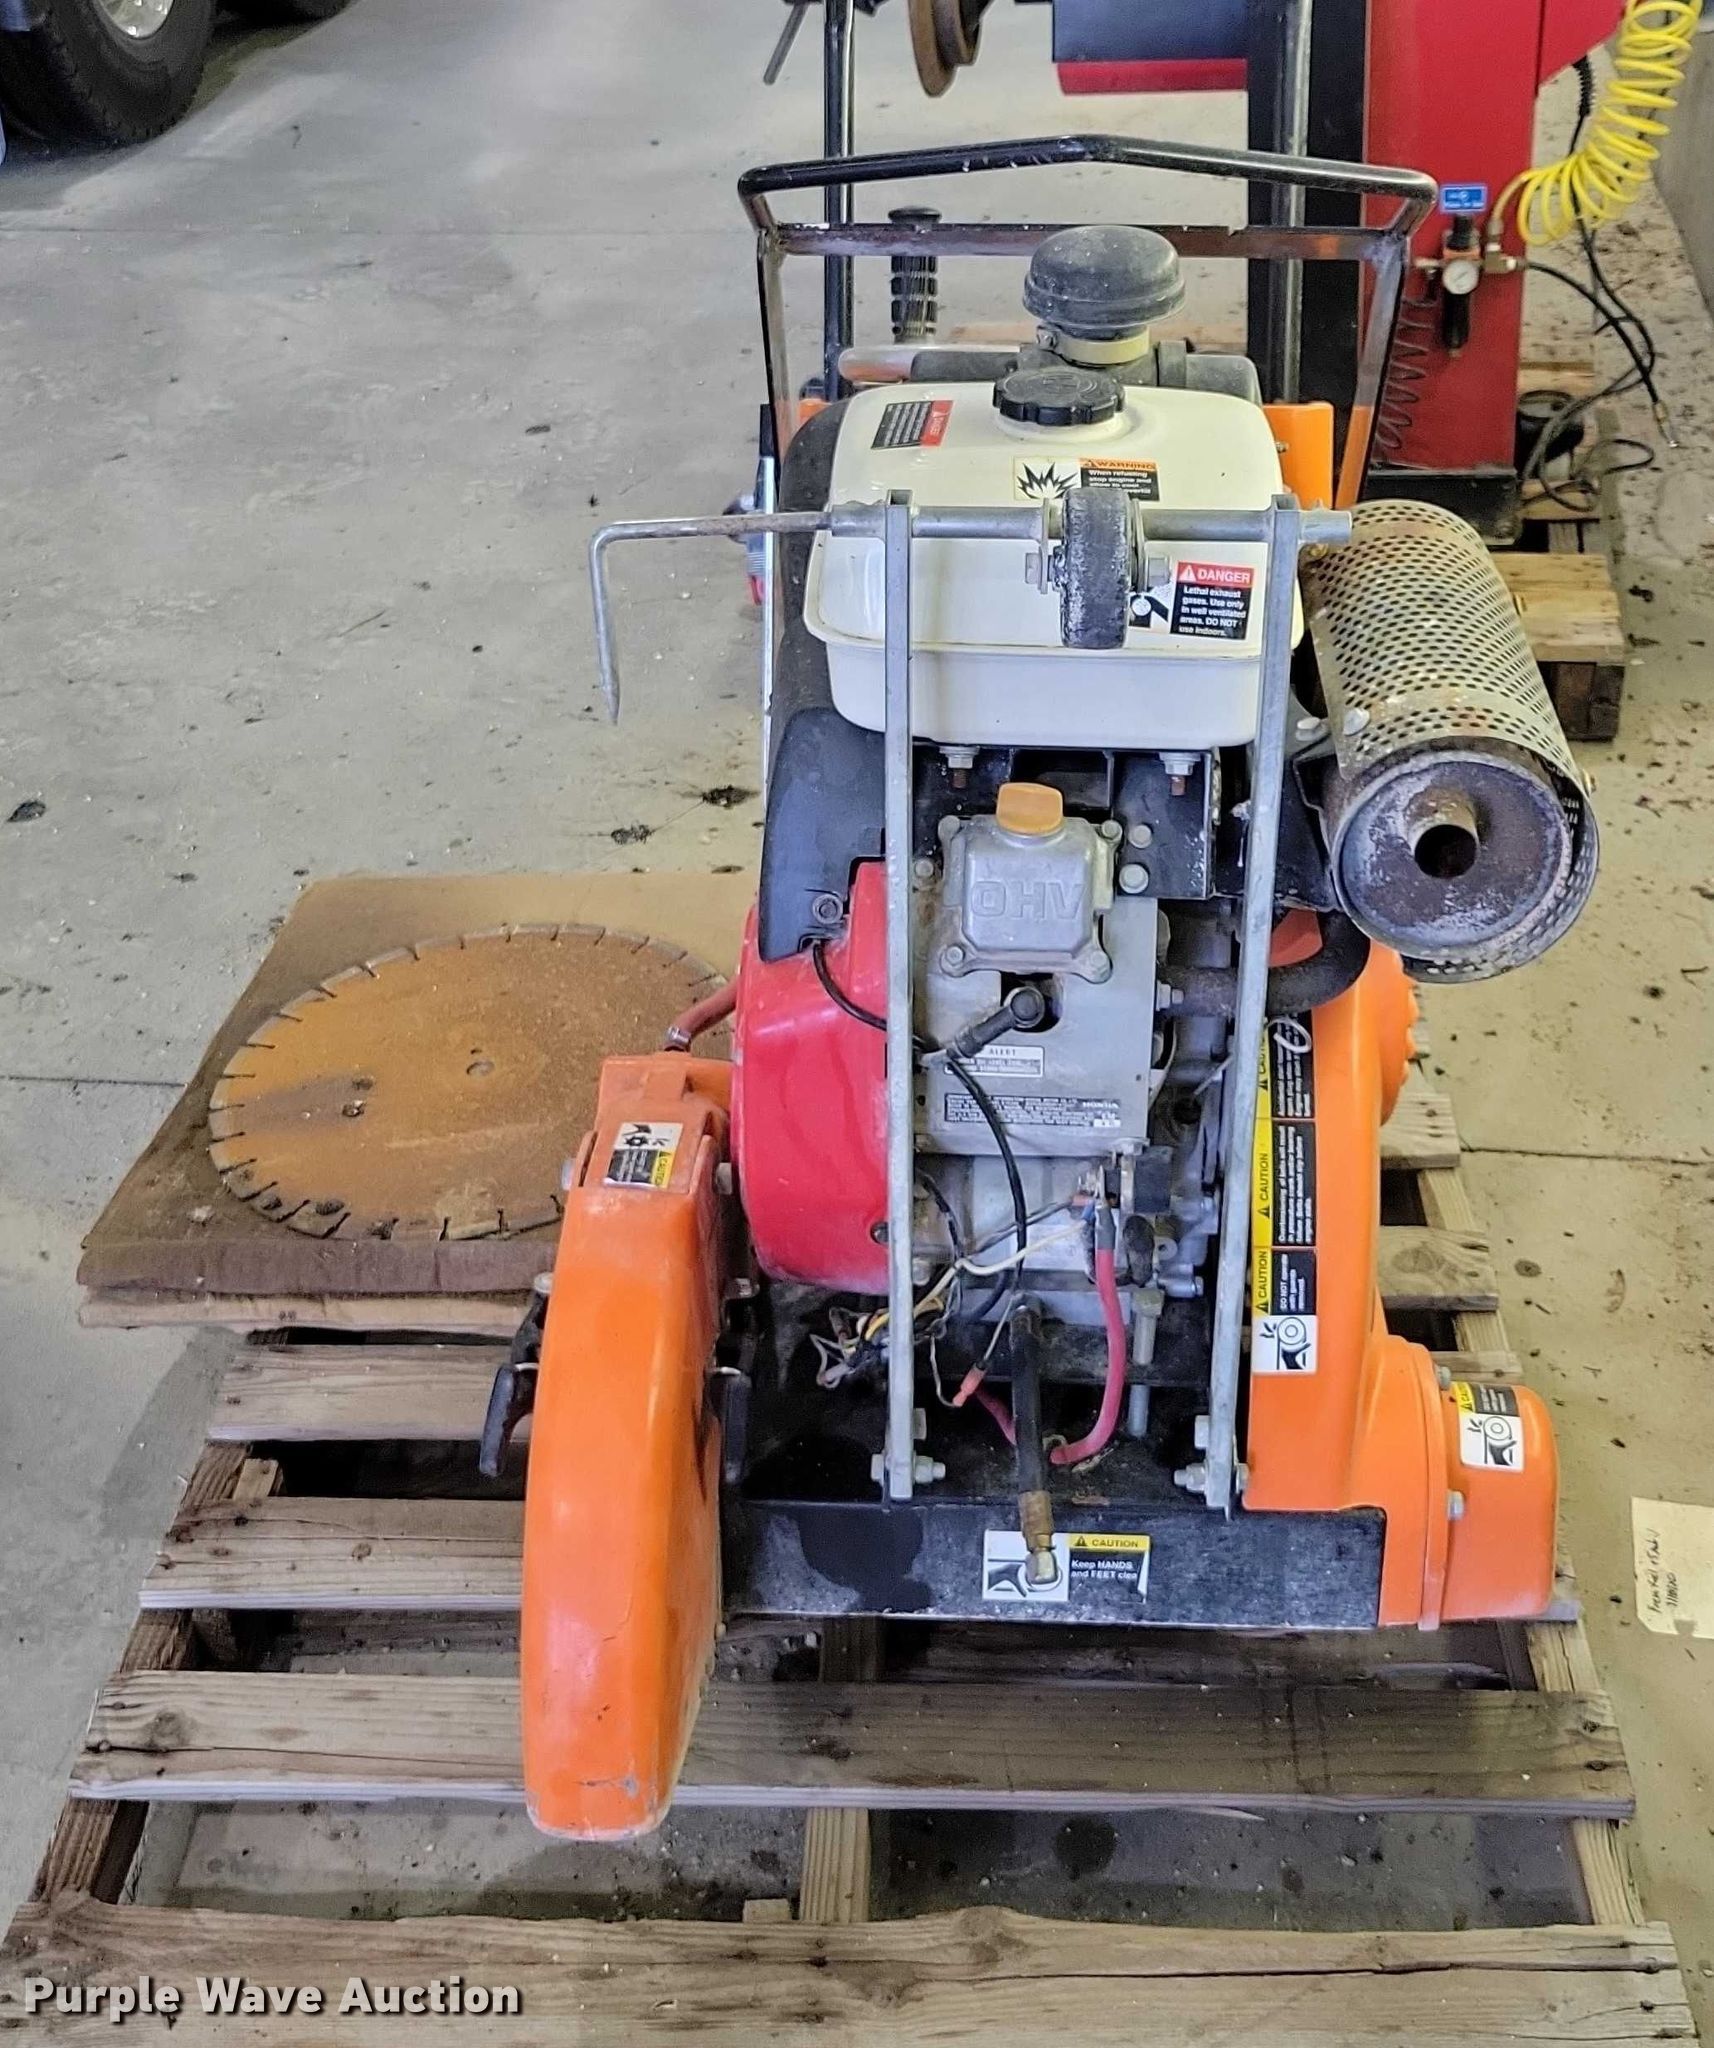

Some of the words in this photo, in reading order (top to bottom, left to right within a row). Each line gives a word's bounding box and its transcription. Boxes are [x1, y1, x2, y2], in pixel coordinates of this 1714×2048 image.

[1097, 461, 1155, 470] WARNING
[1197, 568, 1251, 584] DANGER
[1183, 585, 1209, 596] Lethal
[1209, 588, 1241, 598] exhaust
[1182, 596, 1208, 605] gases.
[1209, 598, 1226, 607] Use
[1226, 600, 1245, 610] only
[1181, 606, 1190, 614] in
[1190, 607, 1208, 615] well
[1208, 609, 1247, 619] ventilated
[1180, 616, 1204, 625] areas.
[1205, 617, 1219, 626] DO
[1219, 619, 1238, 628] NOT
[1179, 625, 1194, 633] use
[971, 880, 1085, 919] OHV
[1259, 1152, 1269, 1201] CAUTION
[1258, 1250, 1268, 1299] CAUTION
[1280, 1281, 1288, 1297] NOT
[1280, 1298, 1288, 1311] DO
[1091, 1538, 1139, 1548] CAUTION
[1071, 1559, 1097, 1571] Keep
[1097, 1560, 1134, 1571] HANDS
[1071, 1570, 1090, 1578] and
[1090, 1570, 1116, 1579] FEET
